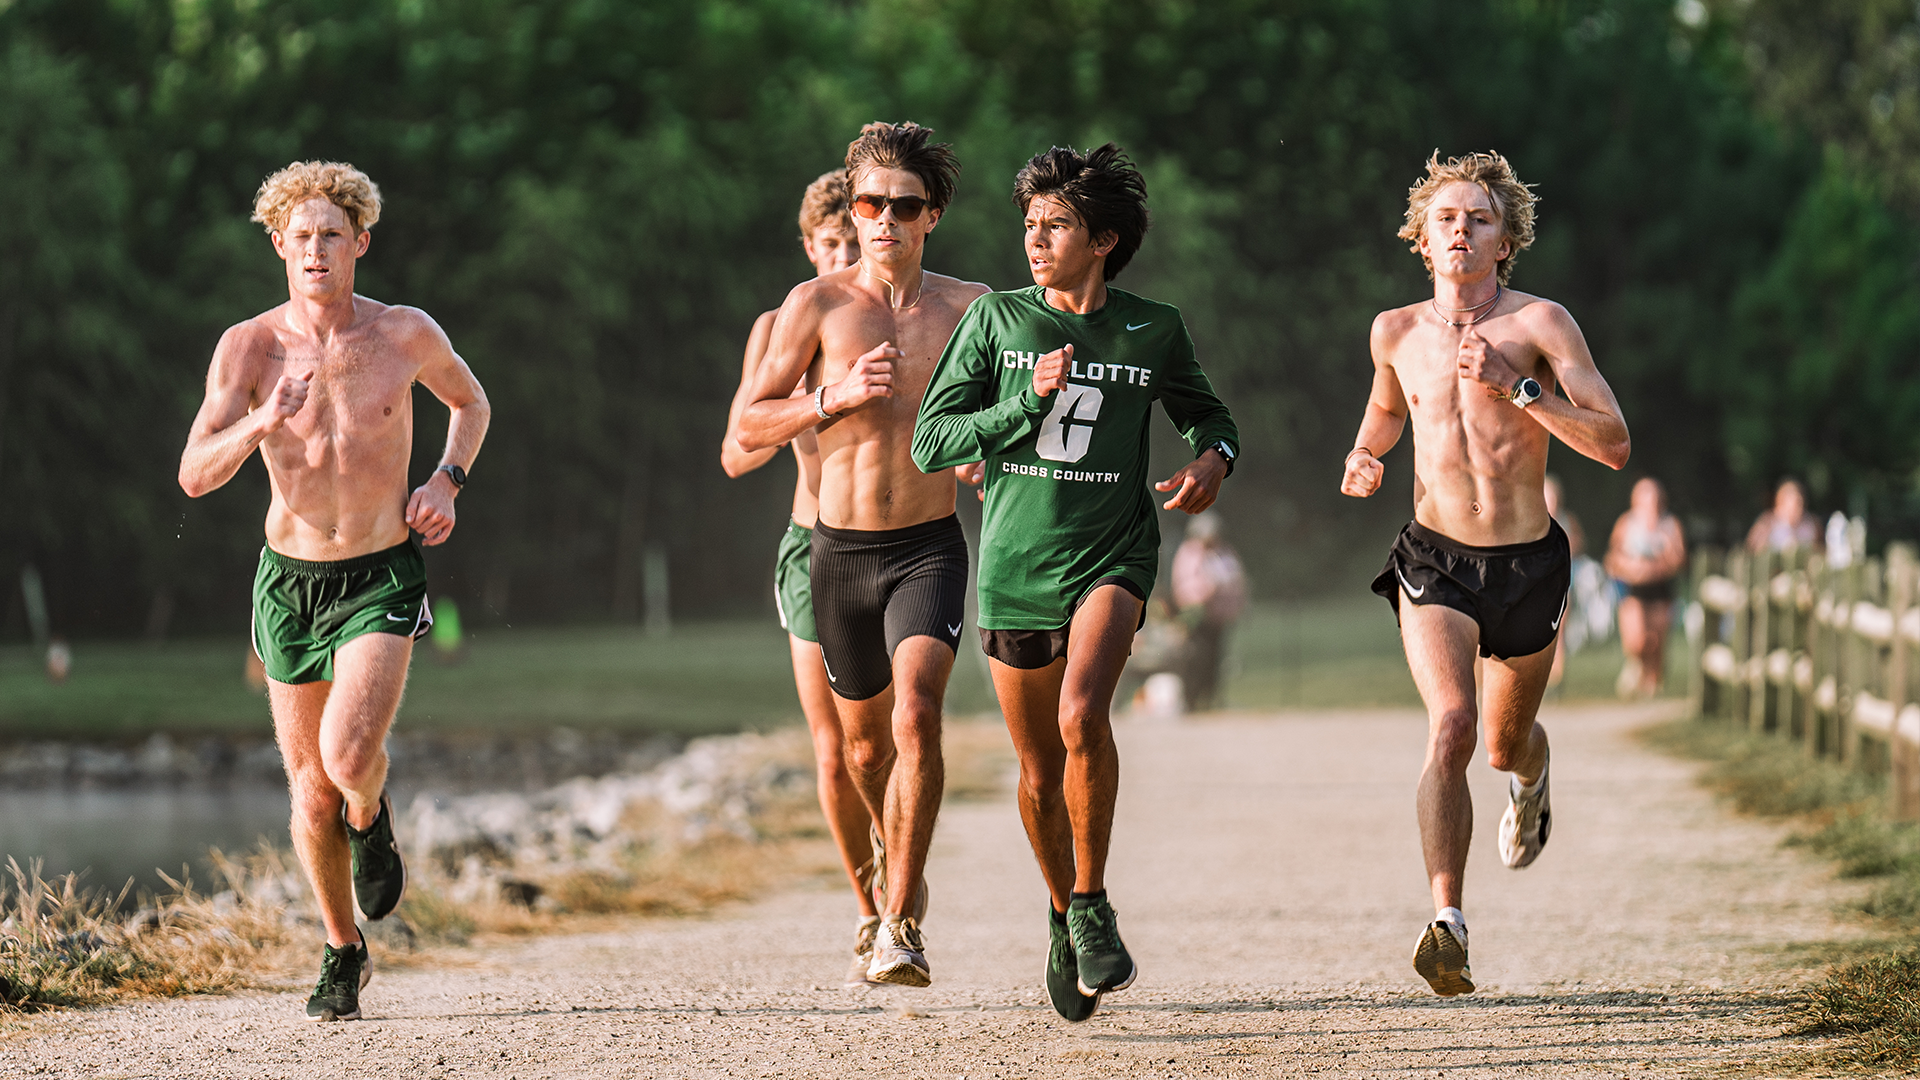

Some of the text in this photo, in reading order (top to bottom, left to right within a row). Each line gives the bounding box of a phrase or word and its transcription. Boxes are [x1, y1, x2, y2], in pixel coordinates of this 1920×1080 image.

[1003, 350, 1152, 387] CHLOTTE
[1035, 382, 1104, 463] C
[1002, 462, 1120, 483] CROSS COUNTRY
